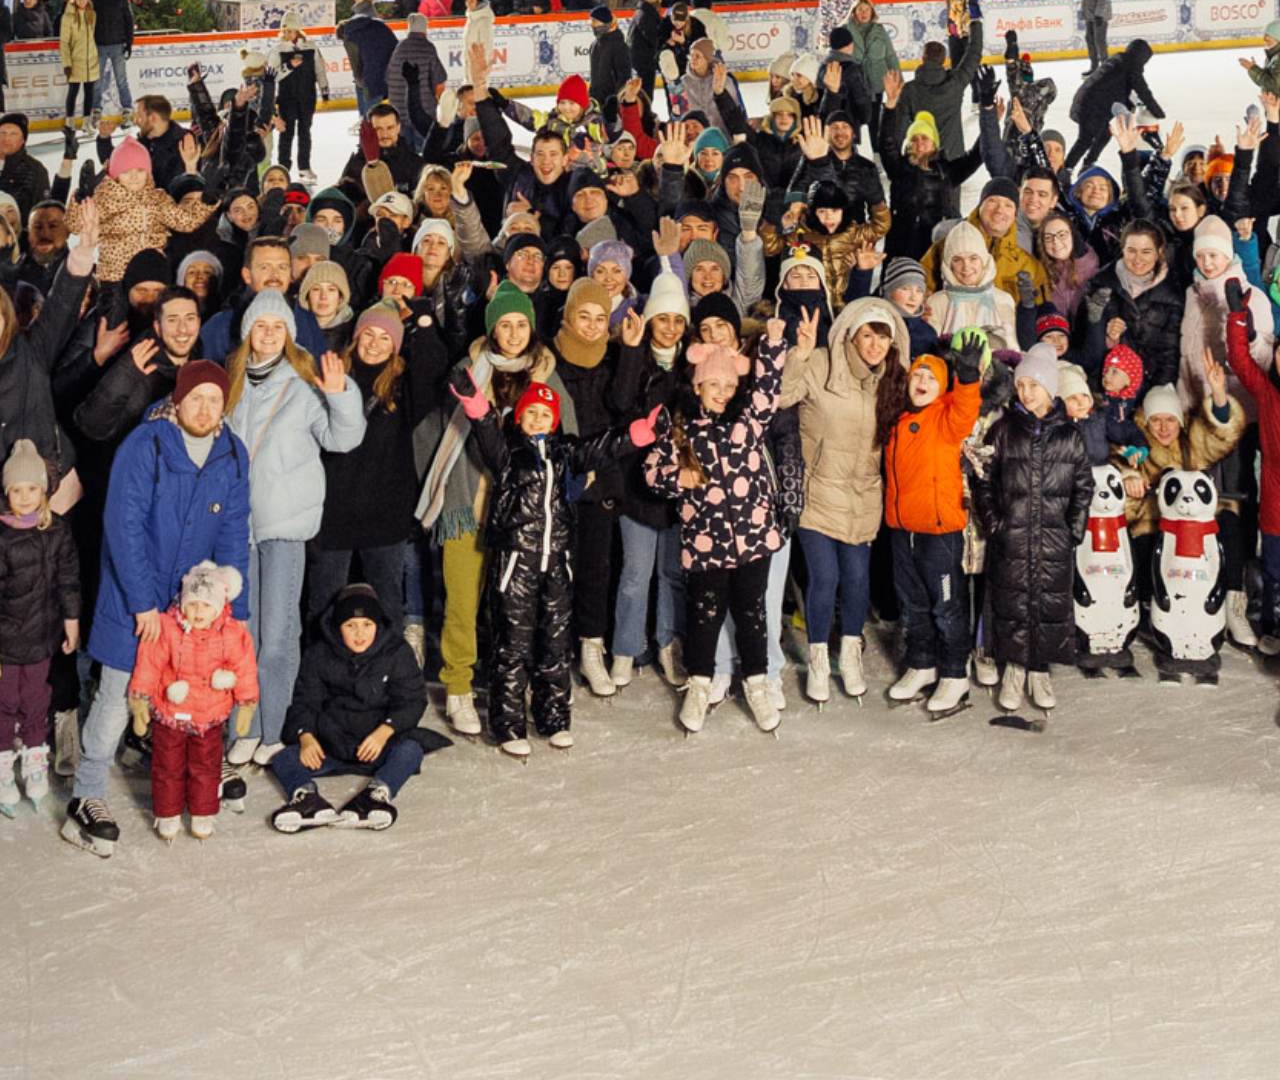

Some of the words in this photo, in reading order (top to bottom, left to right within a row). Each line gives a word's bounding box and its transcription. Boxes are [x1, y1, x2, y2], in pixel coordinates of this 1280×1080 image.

[1211, 3, 1259, 21] BOSCO
[996, 17, 1032, 31] Альфа
[1035, 16, 1062, 28] Банк
[139, 64, 224, 79] ИНГОССРАХ
